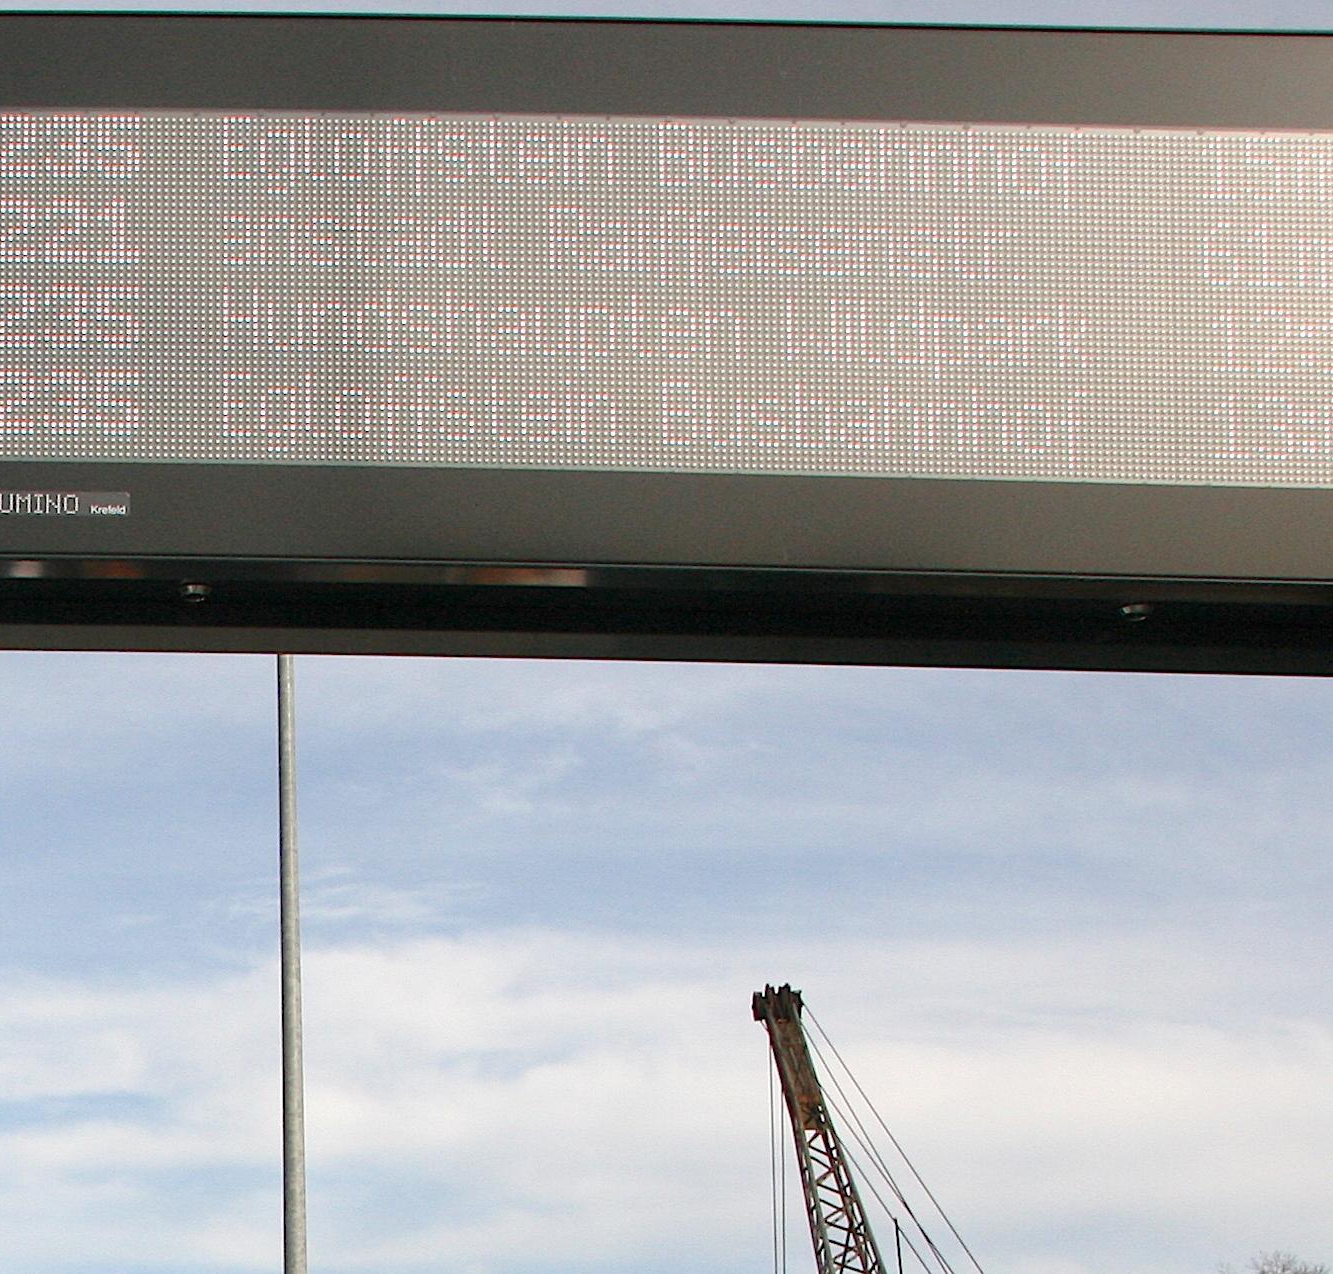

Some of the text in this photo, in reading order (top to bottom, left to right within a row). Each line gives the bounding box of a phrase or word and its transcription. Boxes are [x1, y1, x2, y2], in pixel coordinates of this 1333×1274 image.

[222, 115, 615, 195] Egloffstein
[657, 123, 1079, 208] Busbahnhof
[548, 206, 1026, 288] Raiffeisenstr.
[221, 286, 743, 371] Hundshaupten
[785, 296, 1089, 380] Wildpark
[1210, 308, 1333, 375] 12:
[222, 372, 618, 455] Egloffstein
[659, 381, 1088, 470] Busbahnhof
[90, 504, 127, 515] Krefeld
